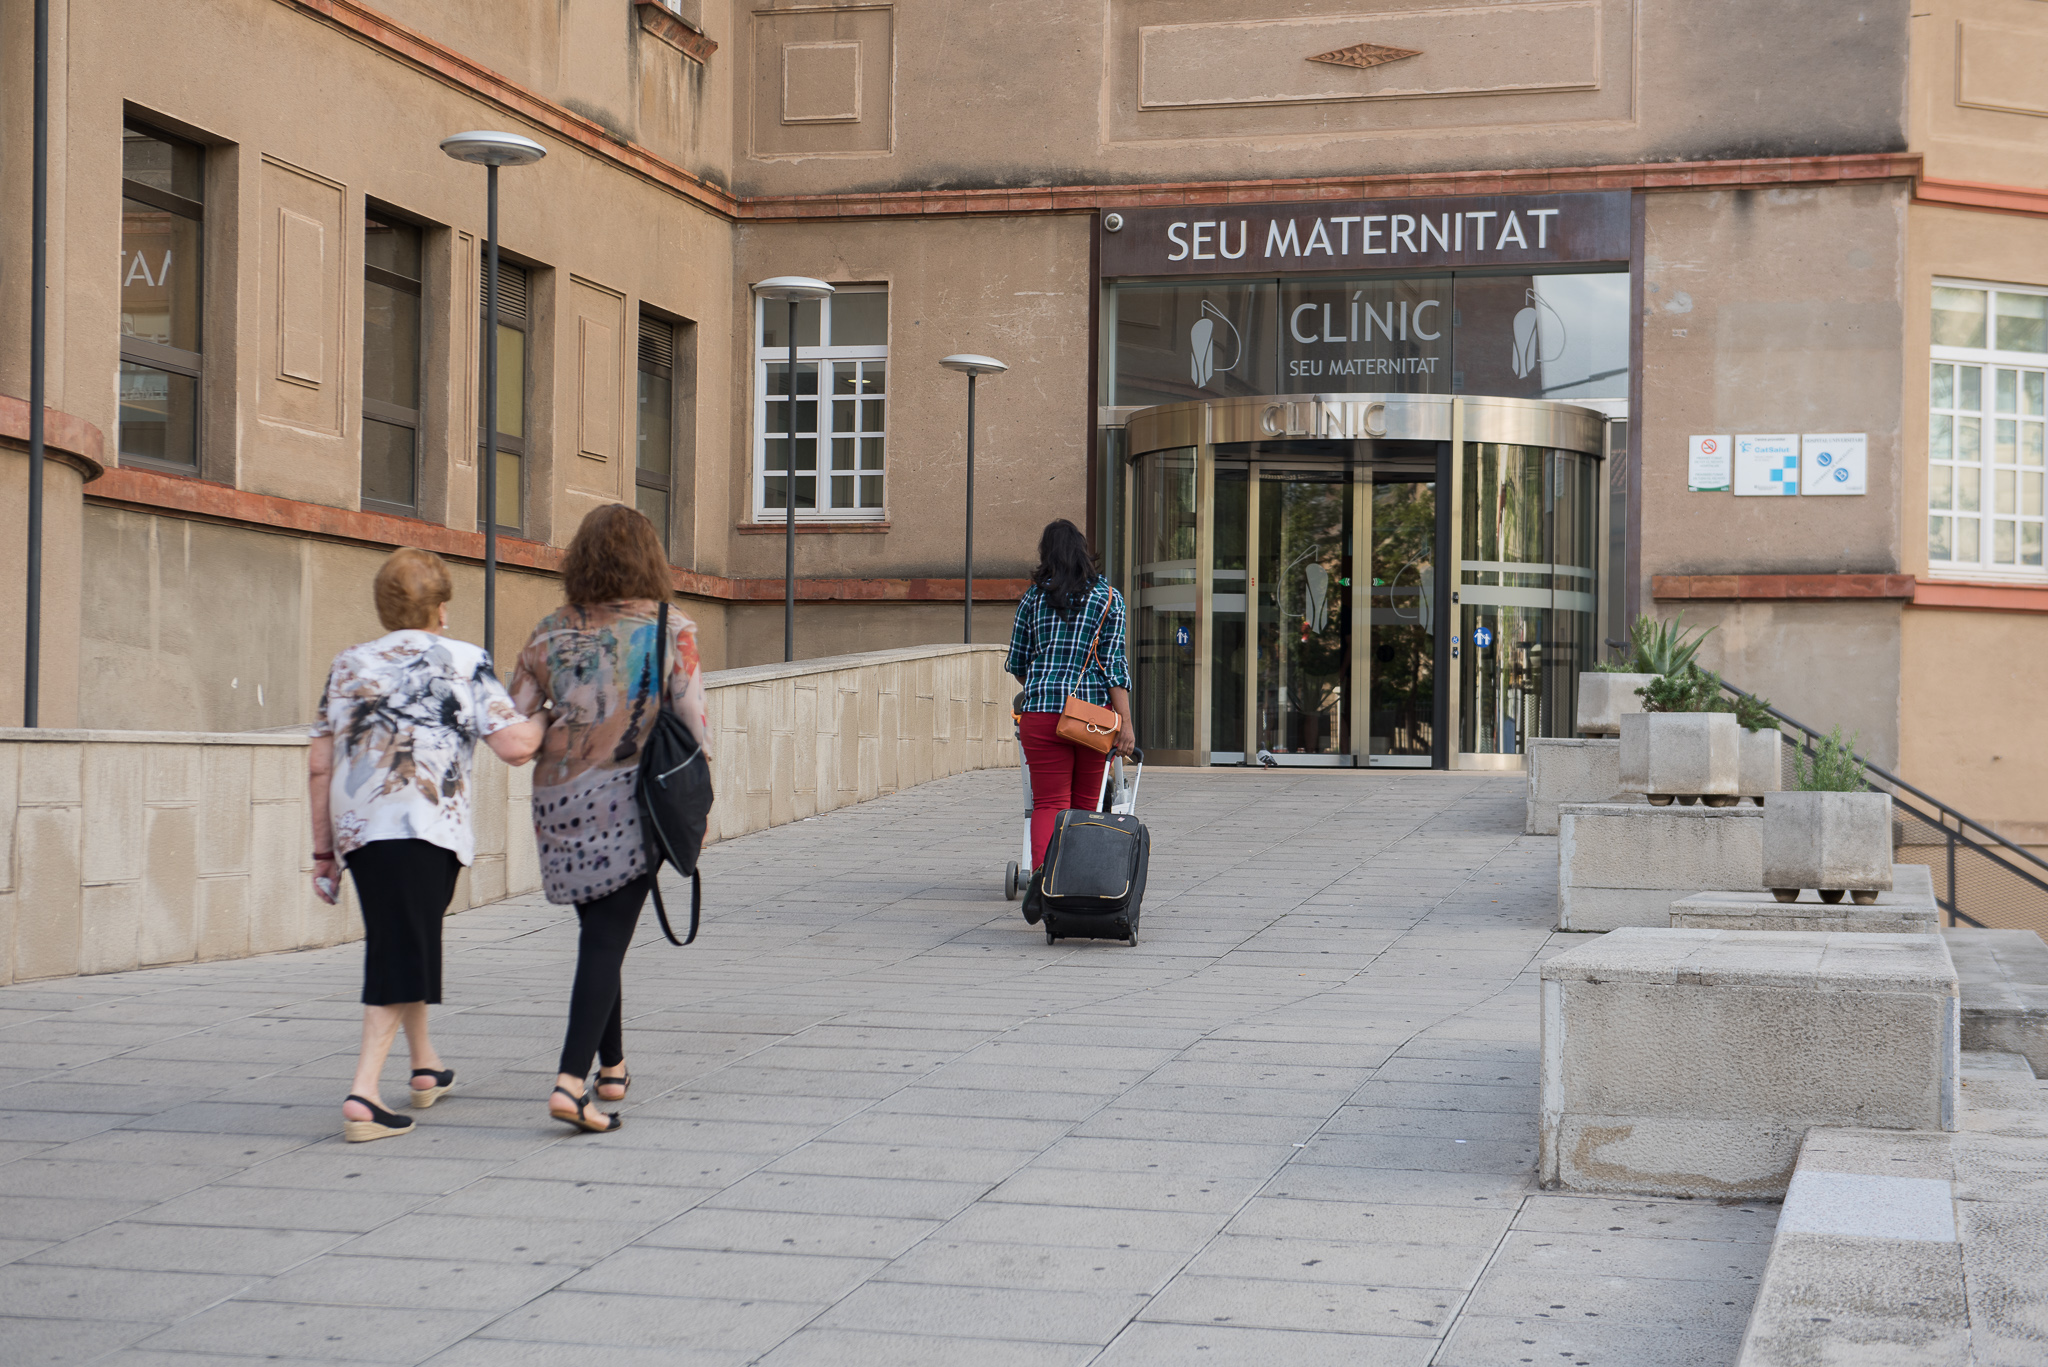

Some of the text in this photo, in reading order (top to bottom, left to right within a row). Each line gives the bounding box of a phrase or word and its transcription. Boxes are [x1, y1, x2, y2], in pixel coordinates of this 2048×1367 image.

[1167, 208, 1559, 261] SEU MATERNITAT
[1290, 290, 1441, 344] CLÍNIC
[1289, 357, 1439, 377] SEU MATERNITAT
[1754, 446, 1790, 454] CatSalut
